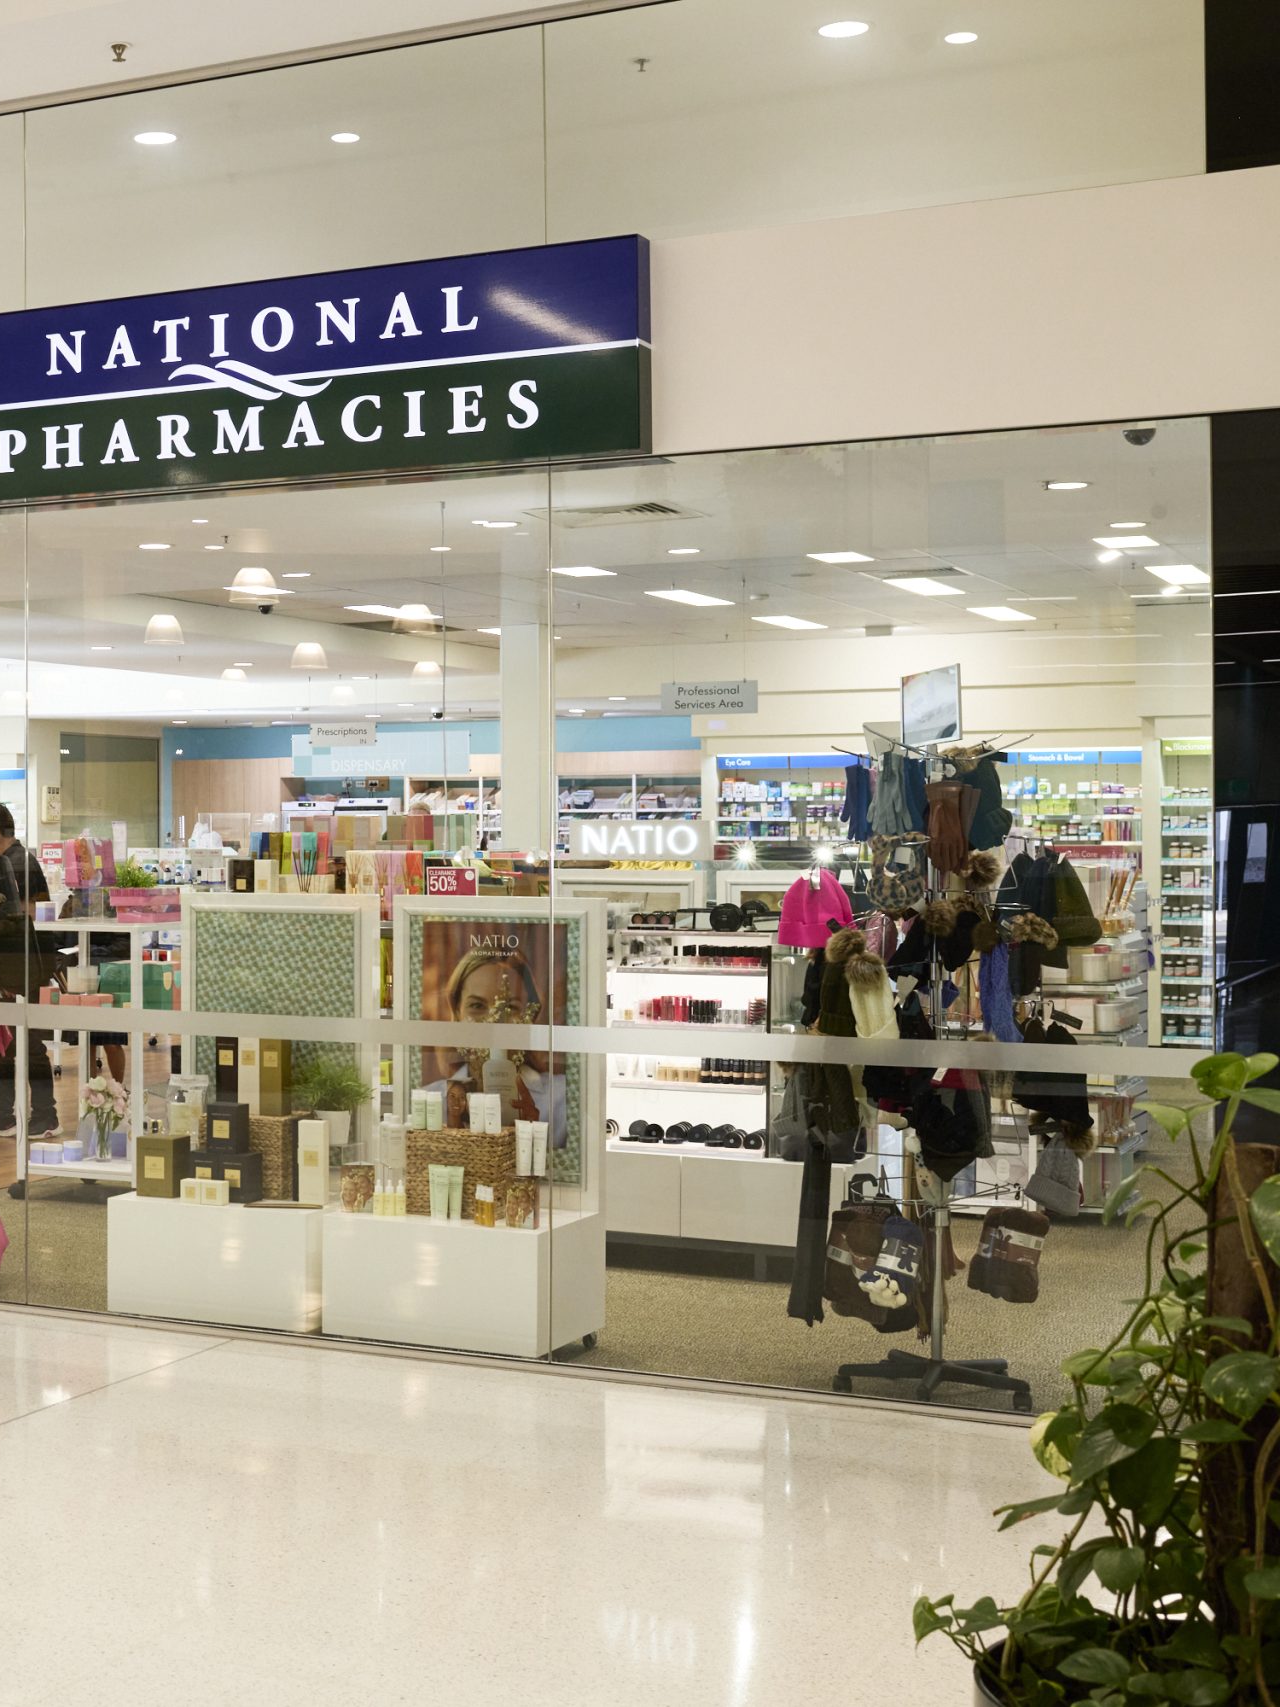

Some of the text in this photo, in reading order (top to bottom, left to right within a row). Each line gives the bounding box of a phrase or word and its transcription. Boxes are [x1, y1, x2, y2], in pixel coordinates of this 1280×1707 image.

[45, 286, 479, 376] NATIONAL
[677, 684, 740, 696] Professional
[674, 699, 744, 710] Services Area
[317, 727, 367, 738] Prescriptions
[725, 758, 751, 767] Eye Care
[1064, 753, 1084, 761] Bowel
[331, 758, 407, 773] DISPENSARY
[581, 824, 700, 856] NATIO
[429, 876, 457, 892] 50%
[470, 934, 519, 948] NATIO
